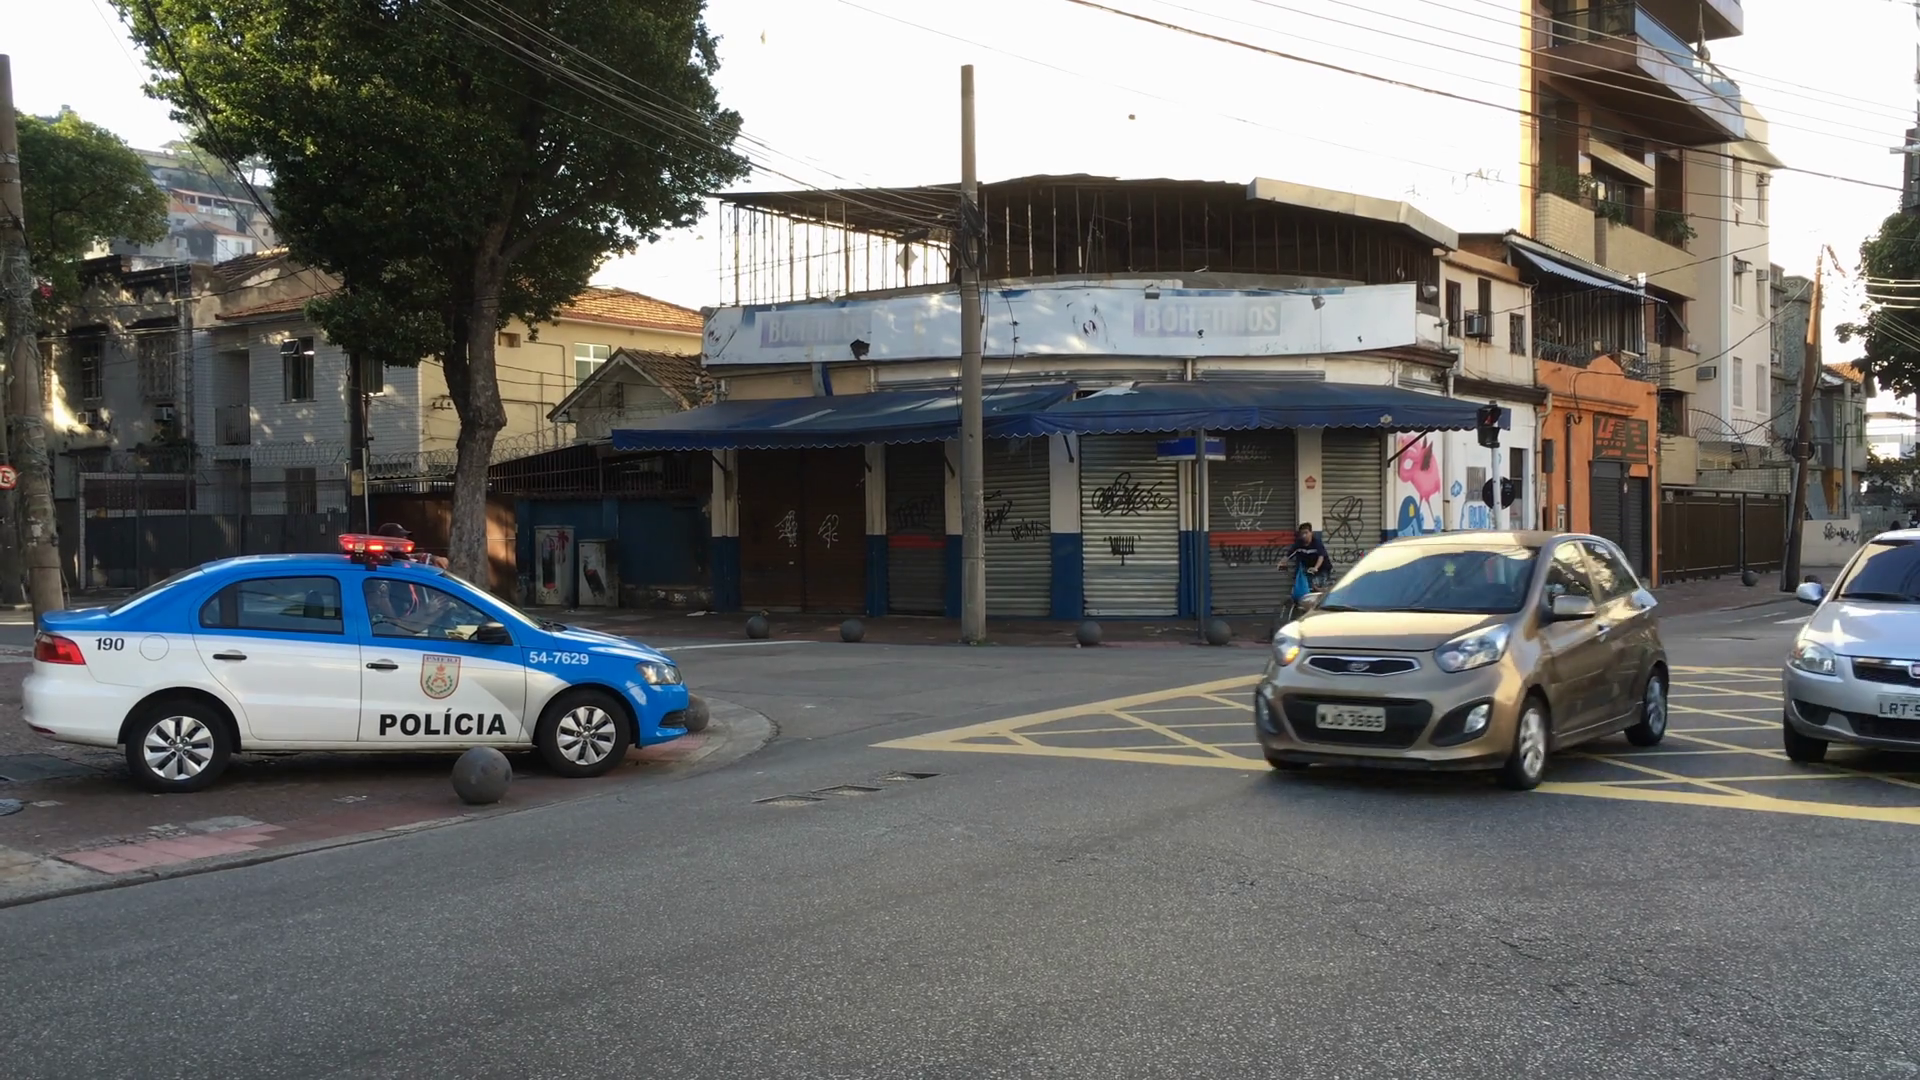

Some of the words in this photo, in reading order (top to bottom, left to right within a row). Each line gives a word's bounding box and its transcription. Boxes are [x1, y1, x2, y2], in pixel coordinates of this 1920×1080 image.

[95, 637, 125, 651] 190
[529, 651, 590, 665] 54-7629
[379, 708, 507, 736] POLÍCIA
